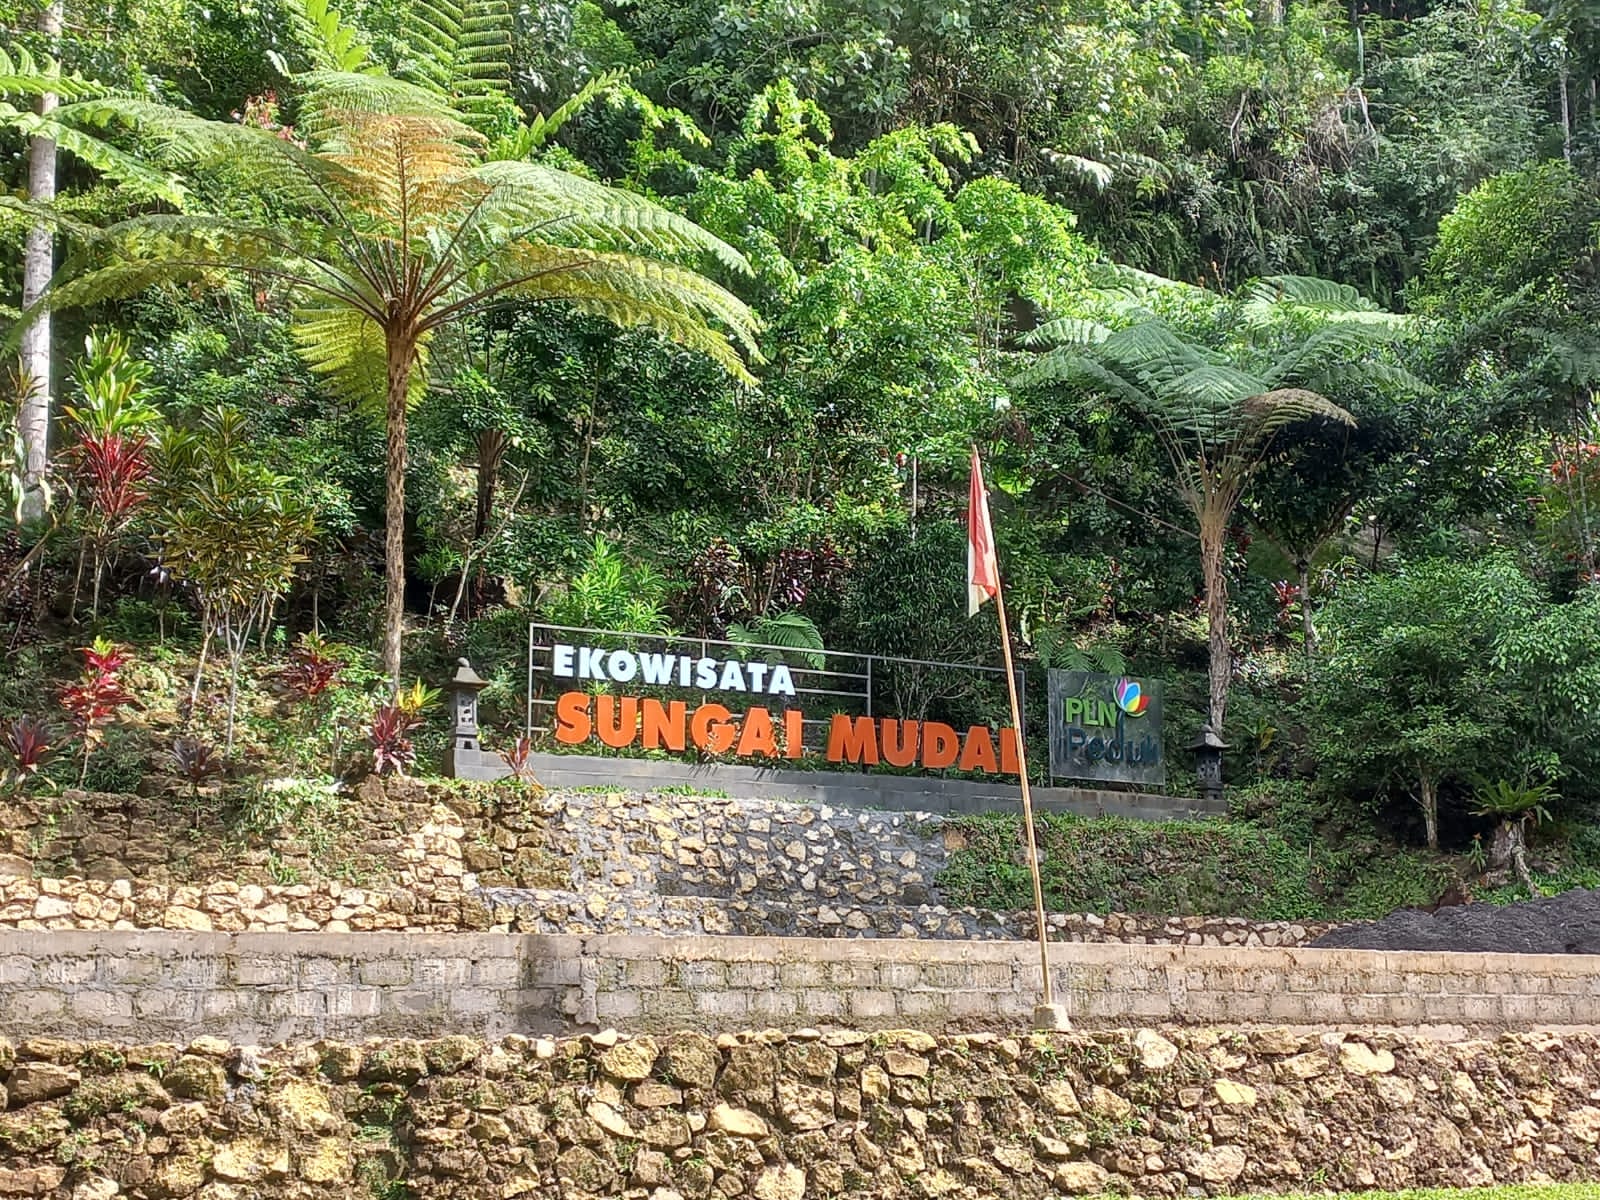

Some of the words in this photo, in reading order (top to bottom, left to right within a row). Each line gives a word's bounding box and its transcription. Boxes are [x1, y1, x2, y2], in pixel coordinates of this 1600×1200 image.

[552, 643, 796, 696] EKOWISATA
[554, 691, 803, 758] SUNGAI
[1065, 697, 1117, 728] PLN
